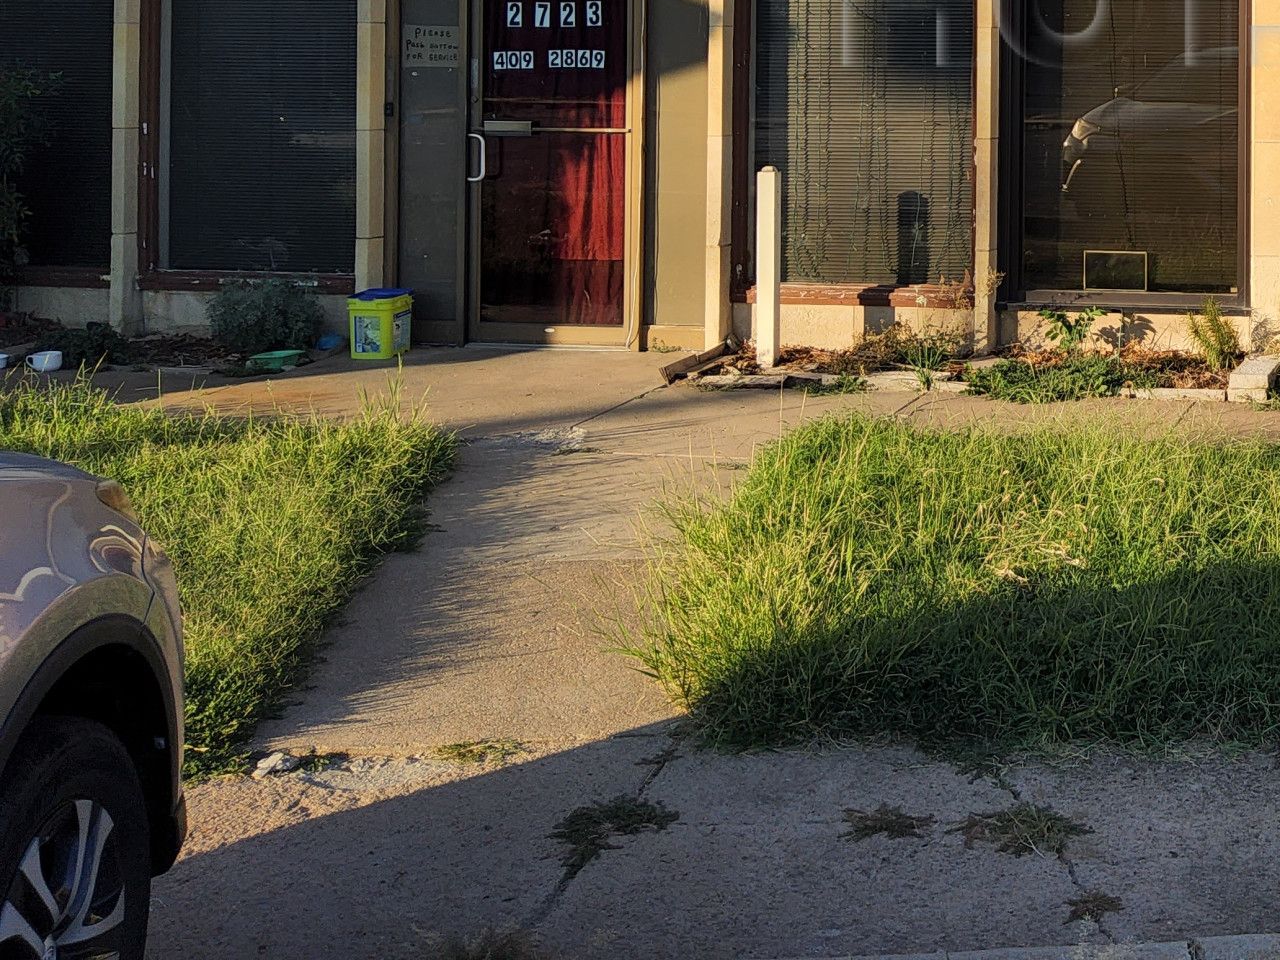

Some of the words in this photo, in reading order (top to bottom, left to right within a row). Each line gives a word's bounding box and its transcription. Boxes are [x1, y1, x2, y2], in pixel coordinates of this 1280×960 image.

[509, 2, 600, 26] 2723
[495, 52, 532, 68] 409
[550, 51, 604, 67] 2869
